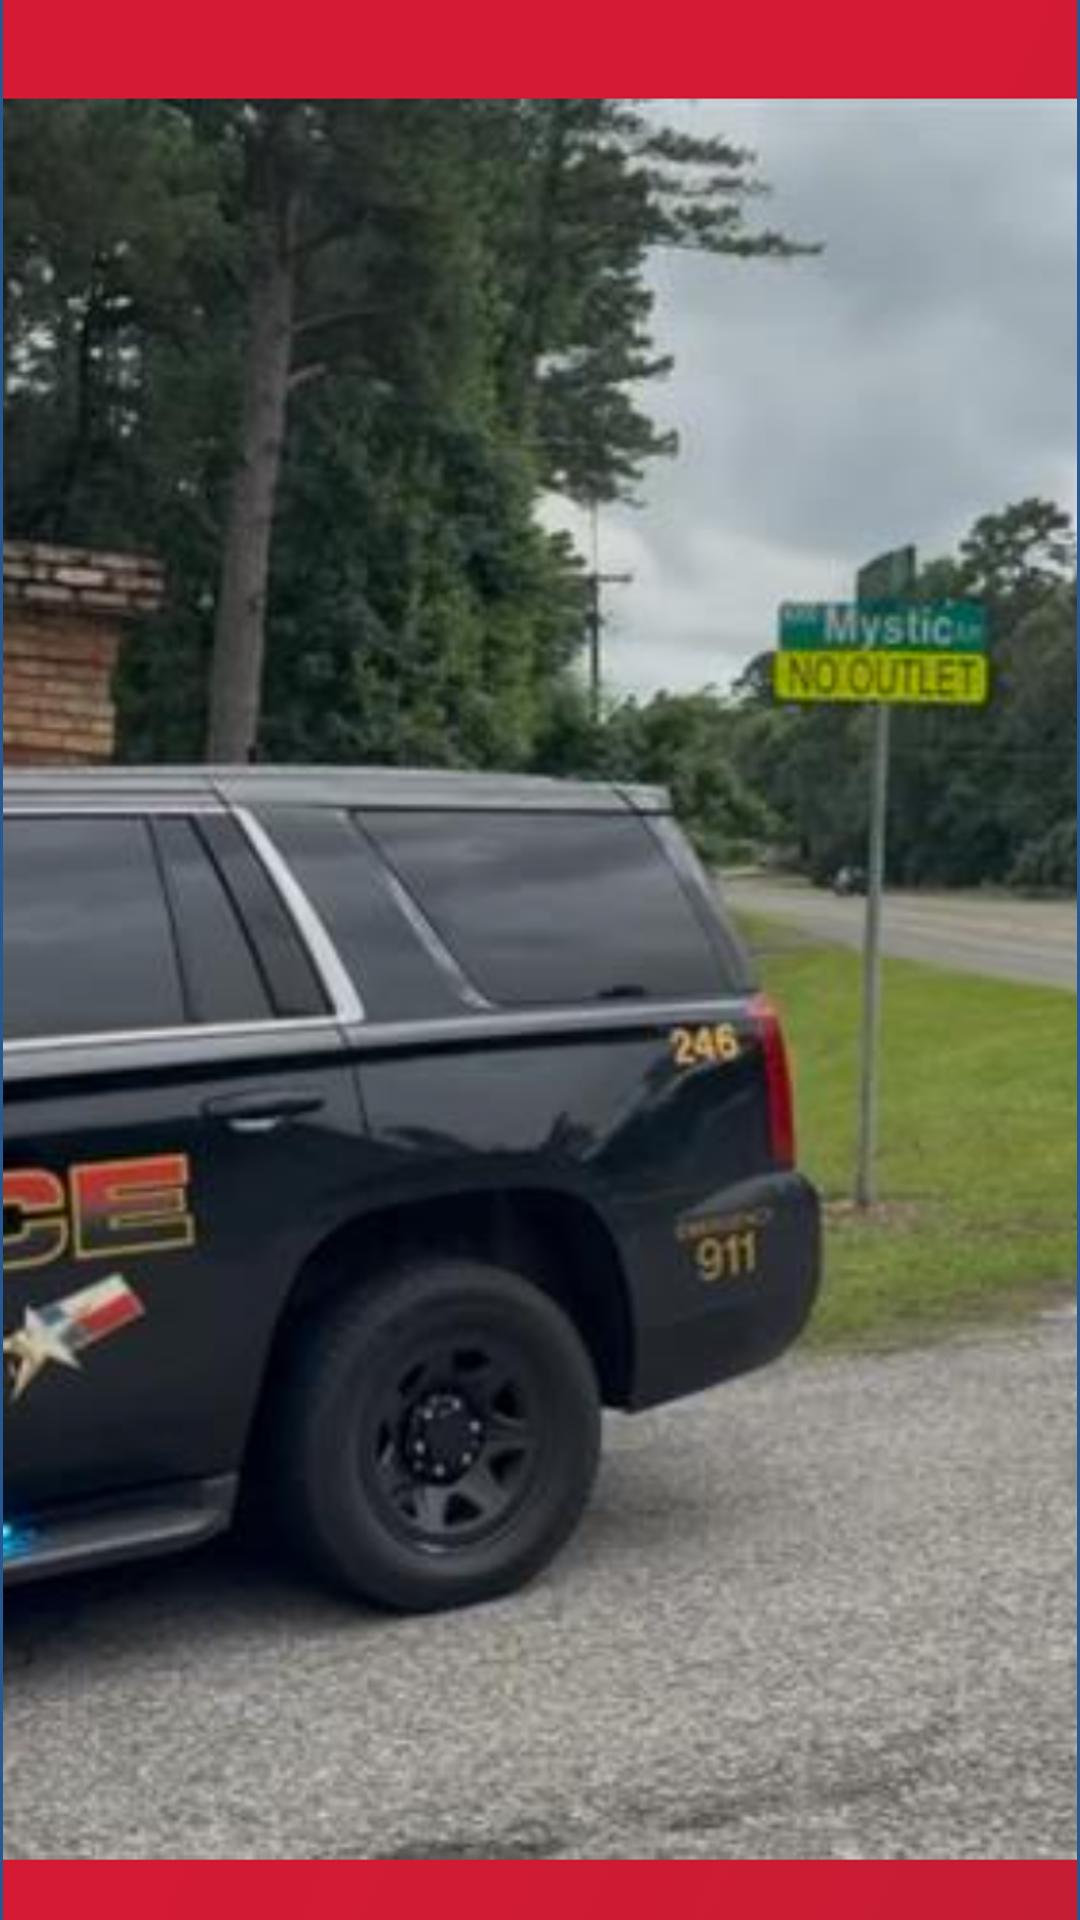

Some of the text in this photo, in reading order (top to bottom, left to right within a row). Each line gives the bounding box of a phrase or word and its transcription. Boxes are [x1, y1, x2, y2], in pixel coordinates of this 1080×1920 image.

[826, 603, 952, 650] Mystic
[789, 657, 976, 694] NO OUTLET
[670, 1023, 740, 1065] 246
[697, 1231, 756, 1280] 911
